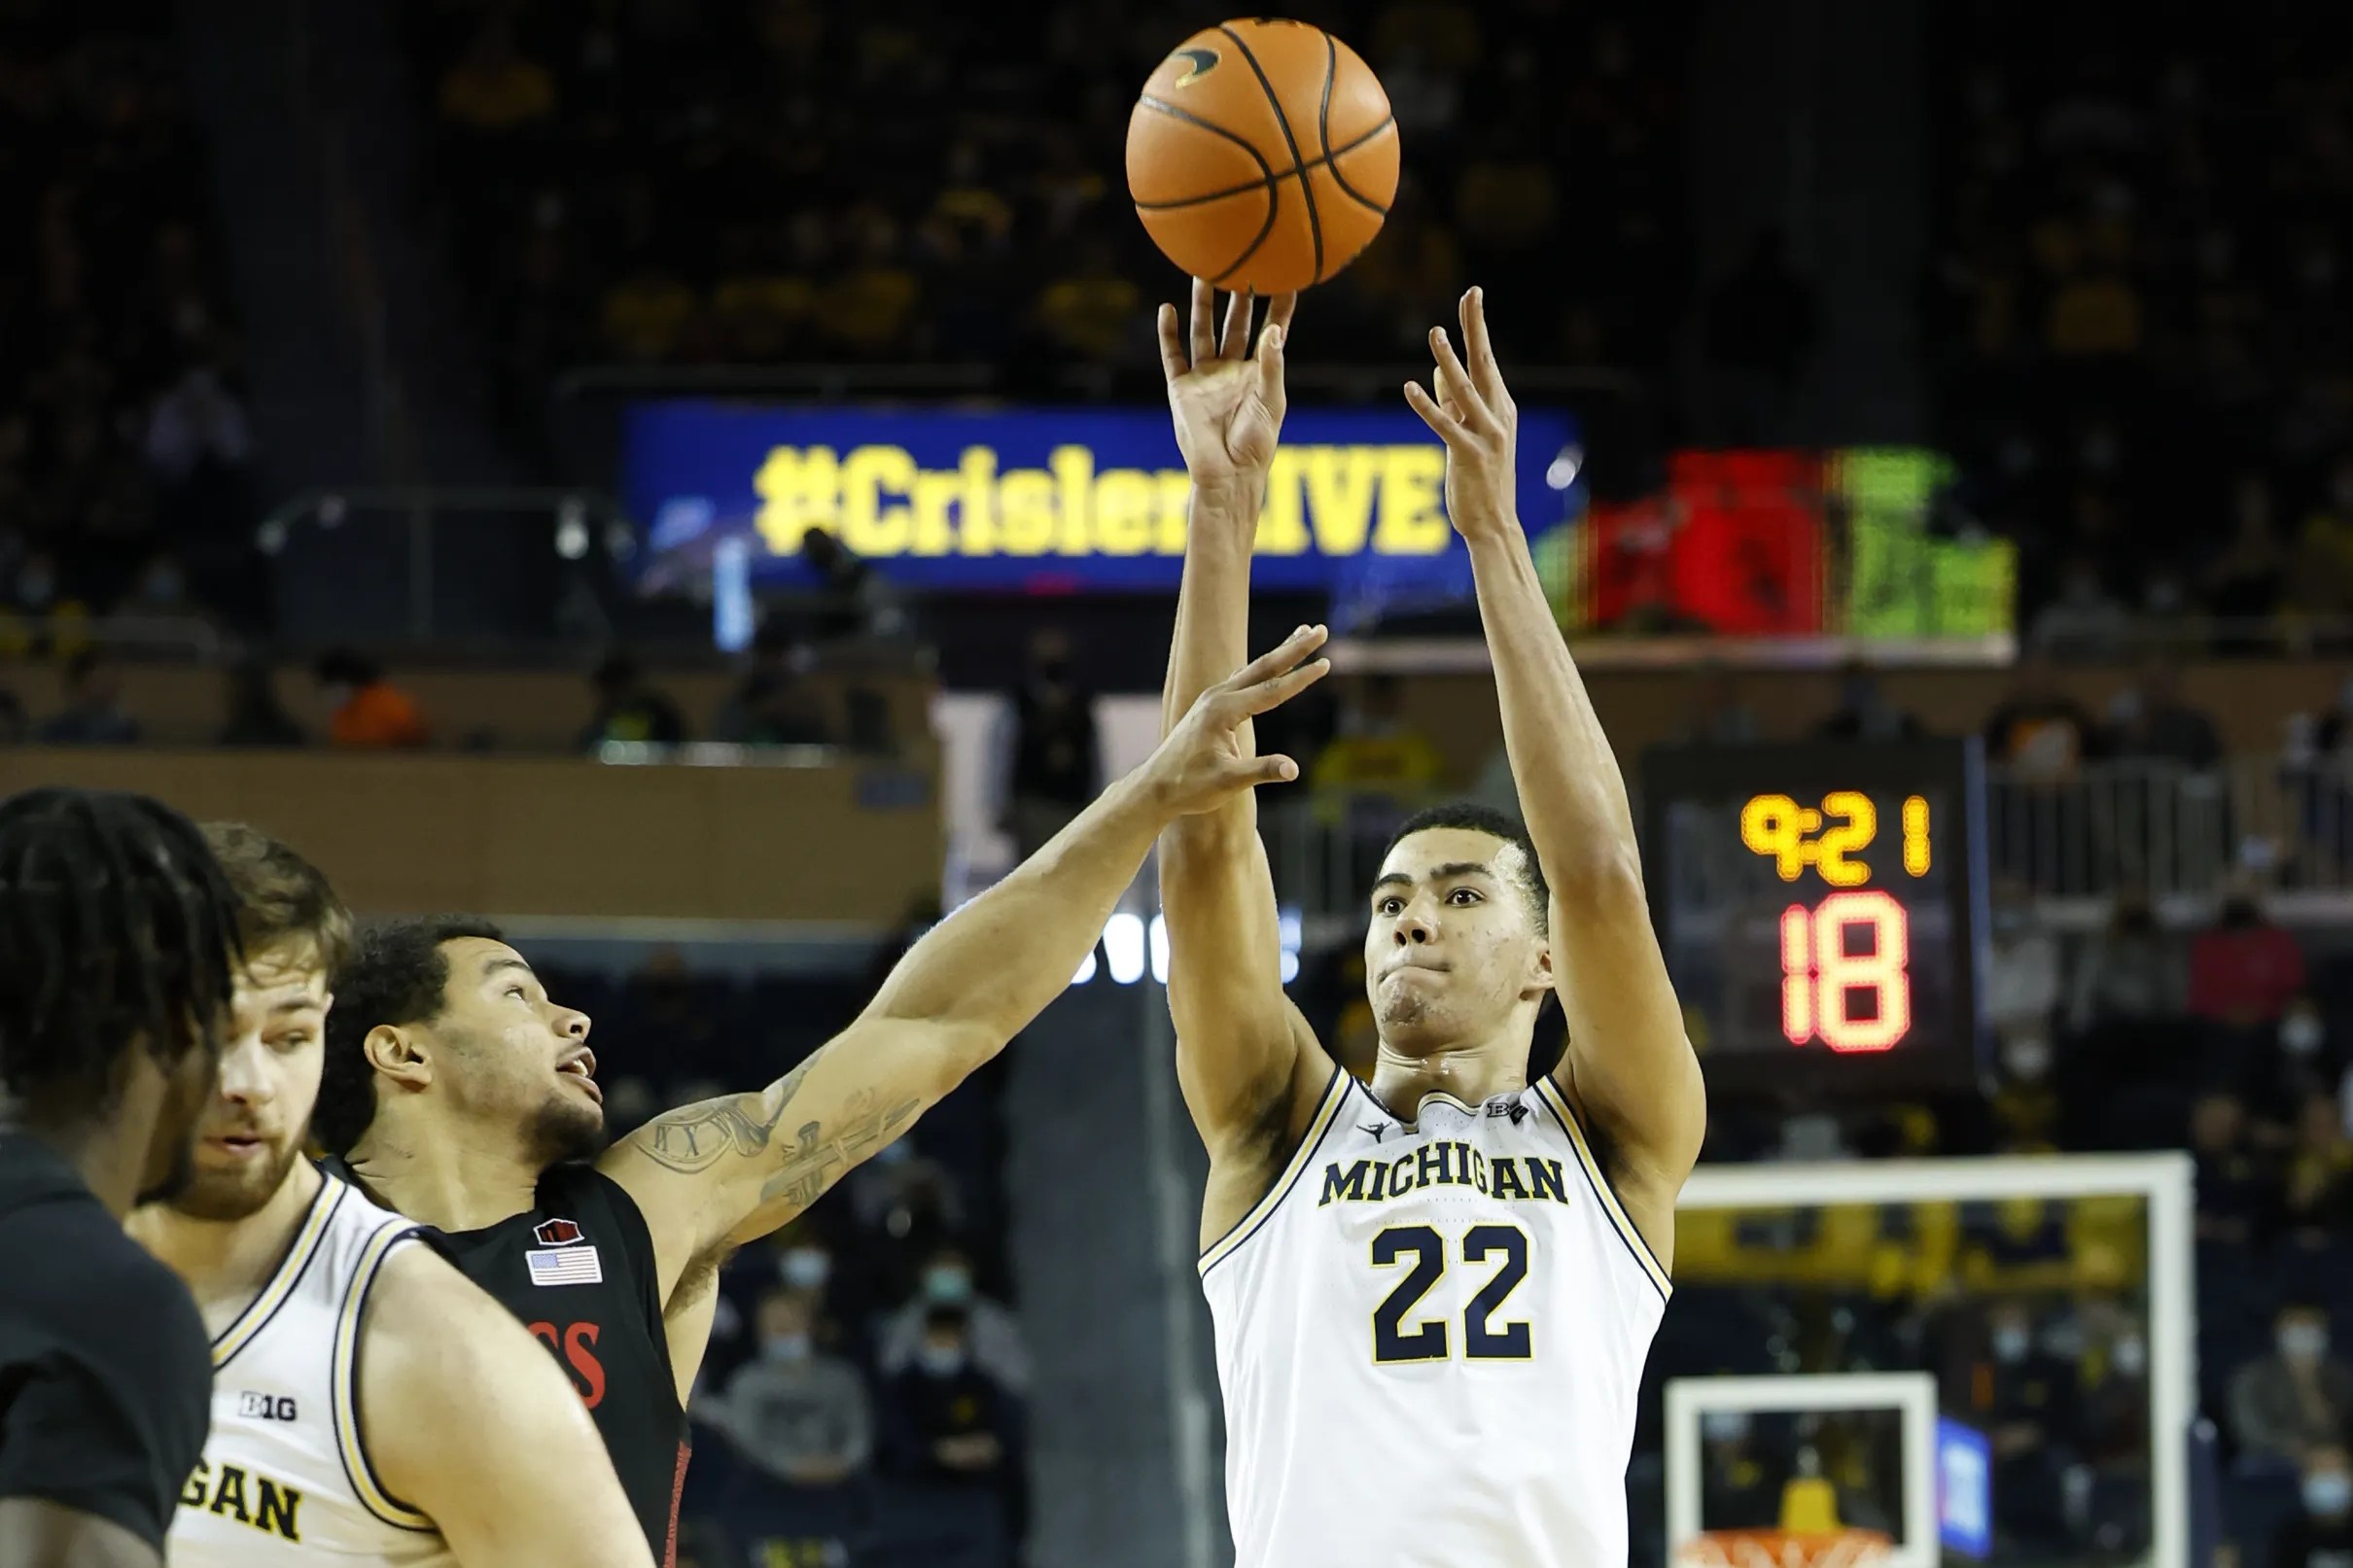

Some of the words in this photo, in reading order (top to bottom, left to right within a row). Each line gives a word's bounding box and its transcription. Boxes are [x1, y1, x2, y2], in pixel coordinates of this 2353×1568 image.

[753, 444, 1451, 557] #CrislerIVE
[1740, 791, 1931, 887] 9:21
[1780, 890, 1911, 1053] 18
[1317, 1138, 1570, 1209] MICHIGAN
[1369, 1222, 1535, 1365] 22
